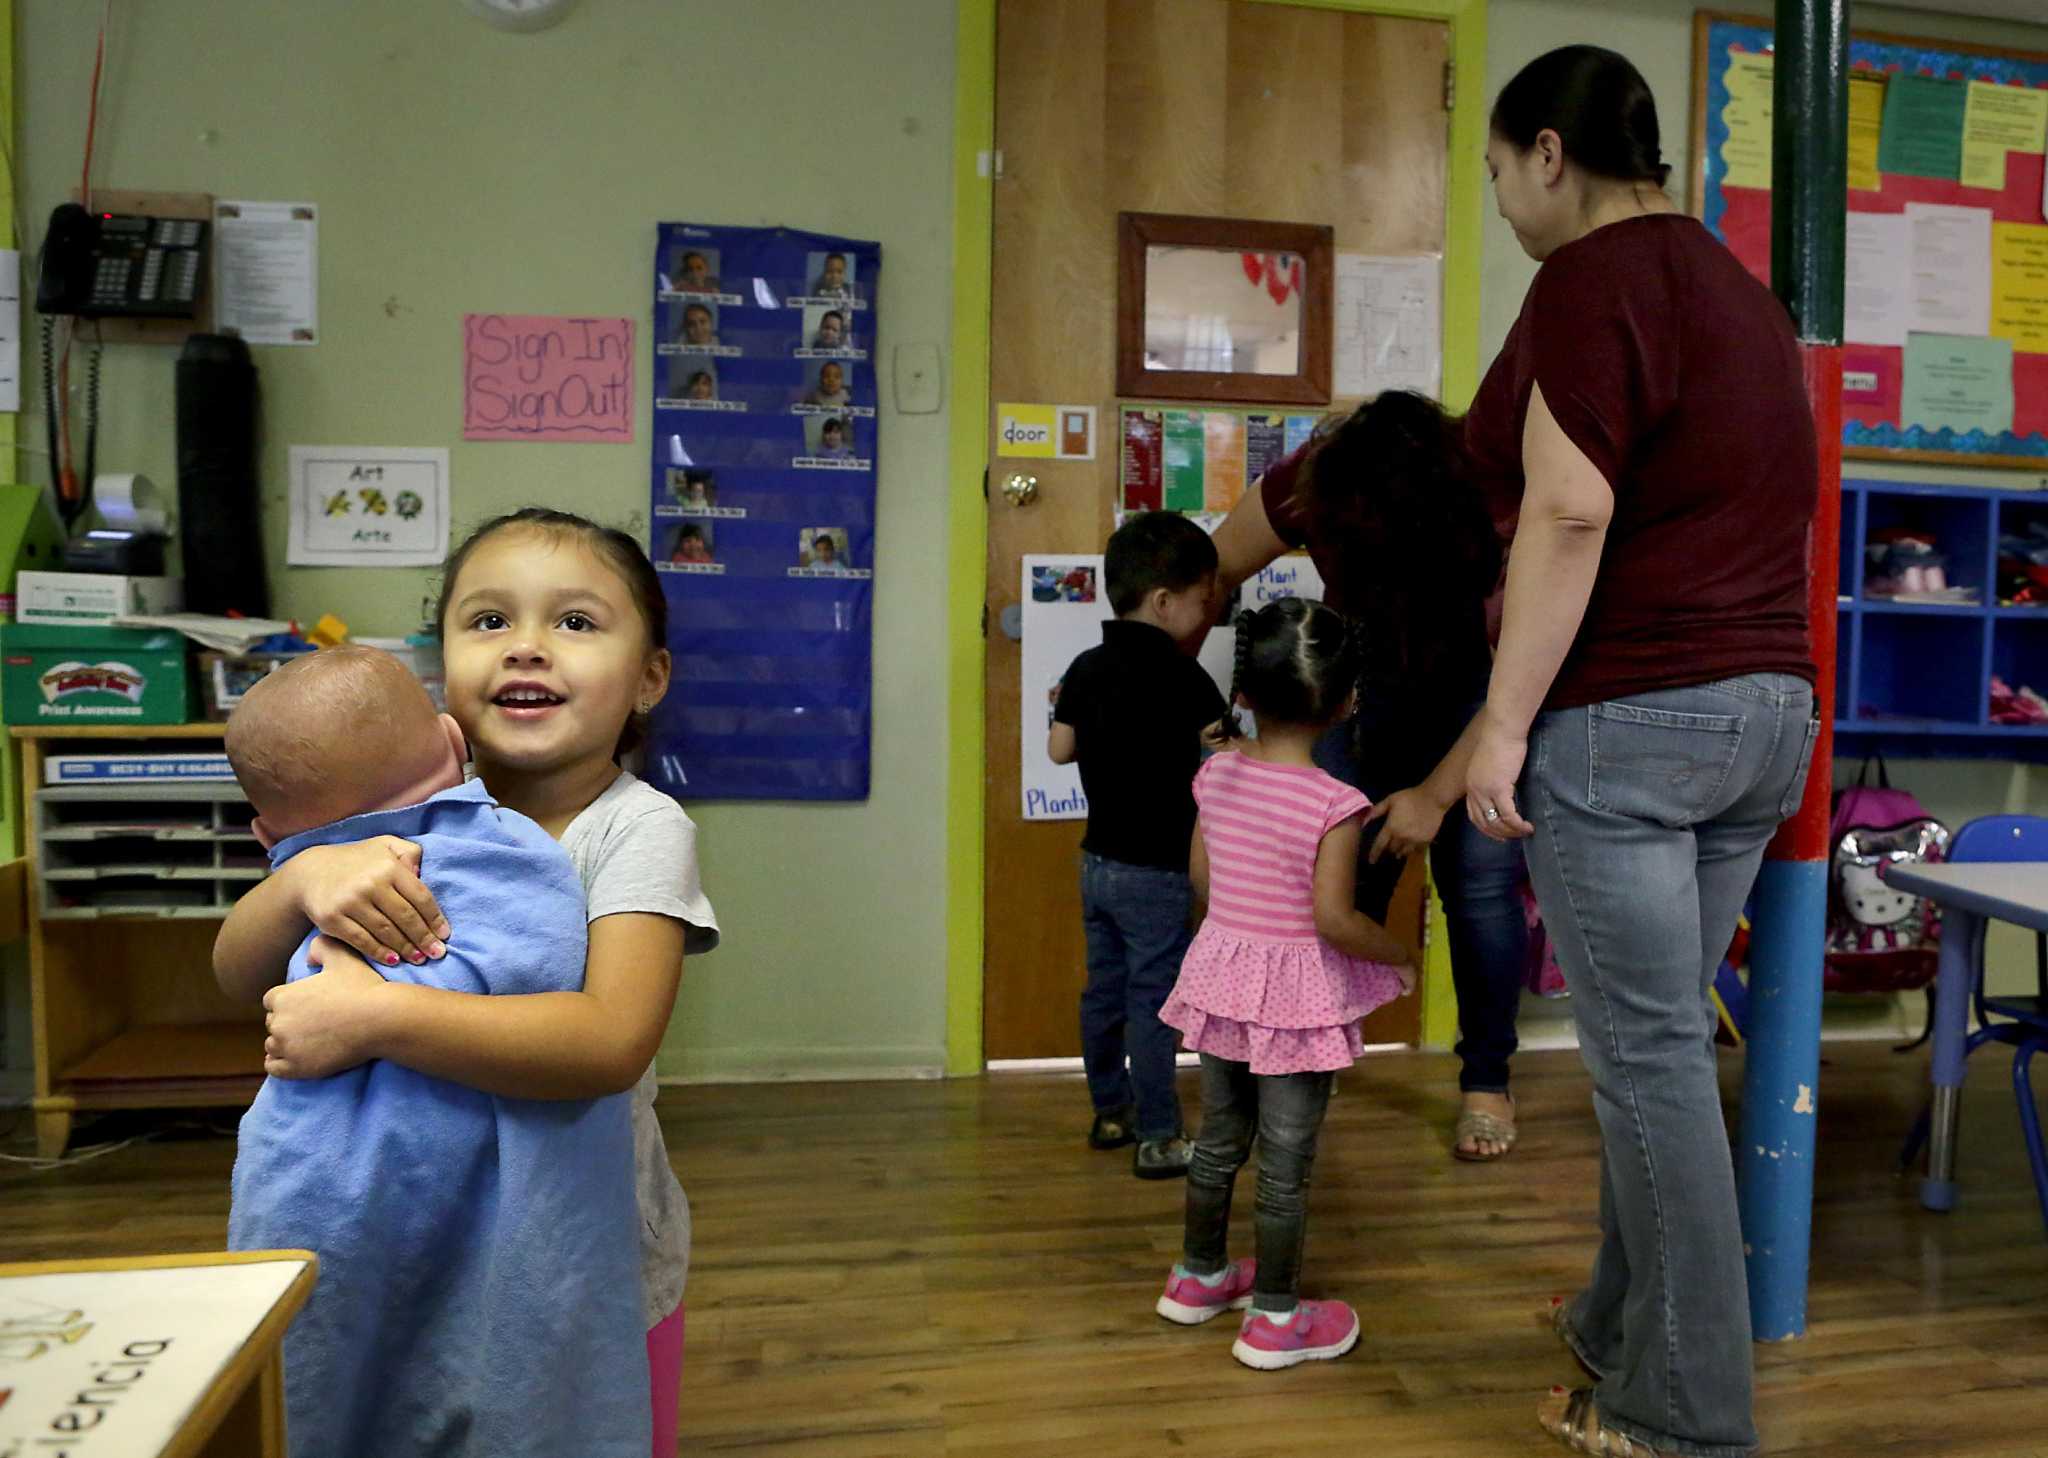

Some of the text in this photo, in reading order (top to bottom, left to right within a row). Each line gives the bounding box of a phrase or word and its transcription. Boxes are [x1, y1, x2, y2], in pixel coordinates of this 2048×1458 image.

[473, 315, 623, 384] Sign In
[1003, 420, 1047, 446] door
[348, 465, 384, 481] Art
[352, 530, 392, 543] Arte
[1257, 565, 1297, 584] Plant
[0, 1337, 174, 1458] iencia
